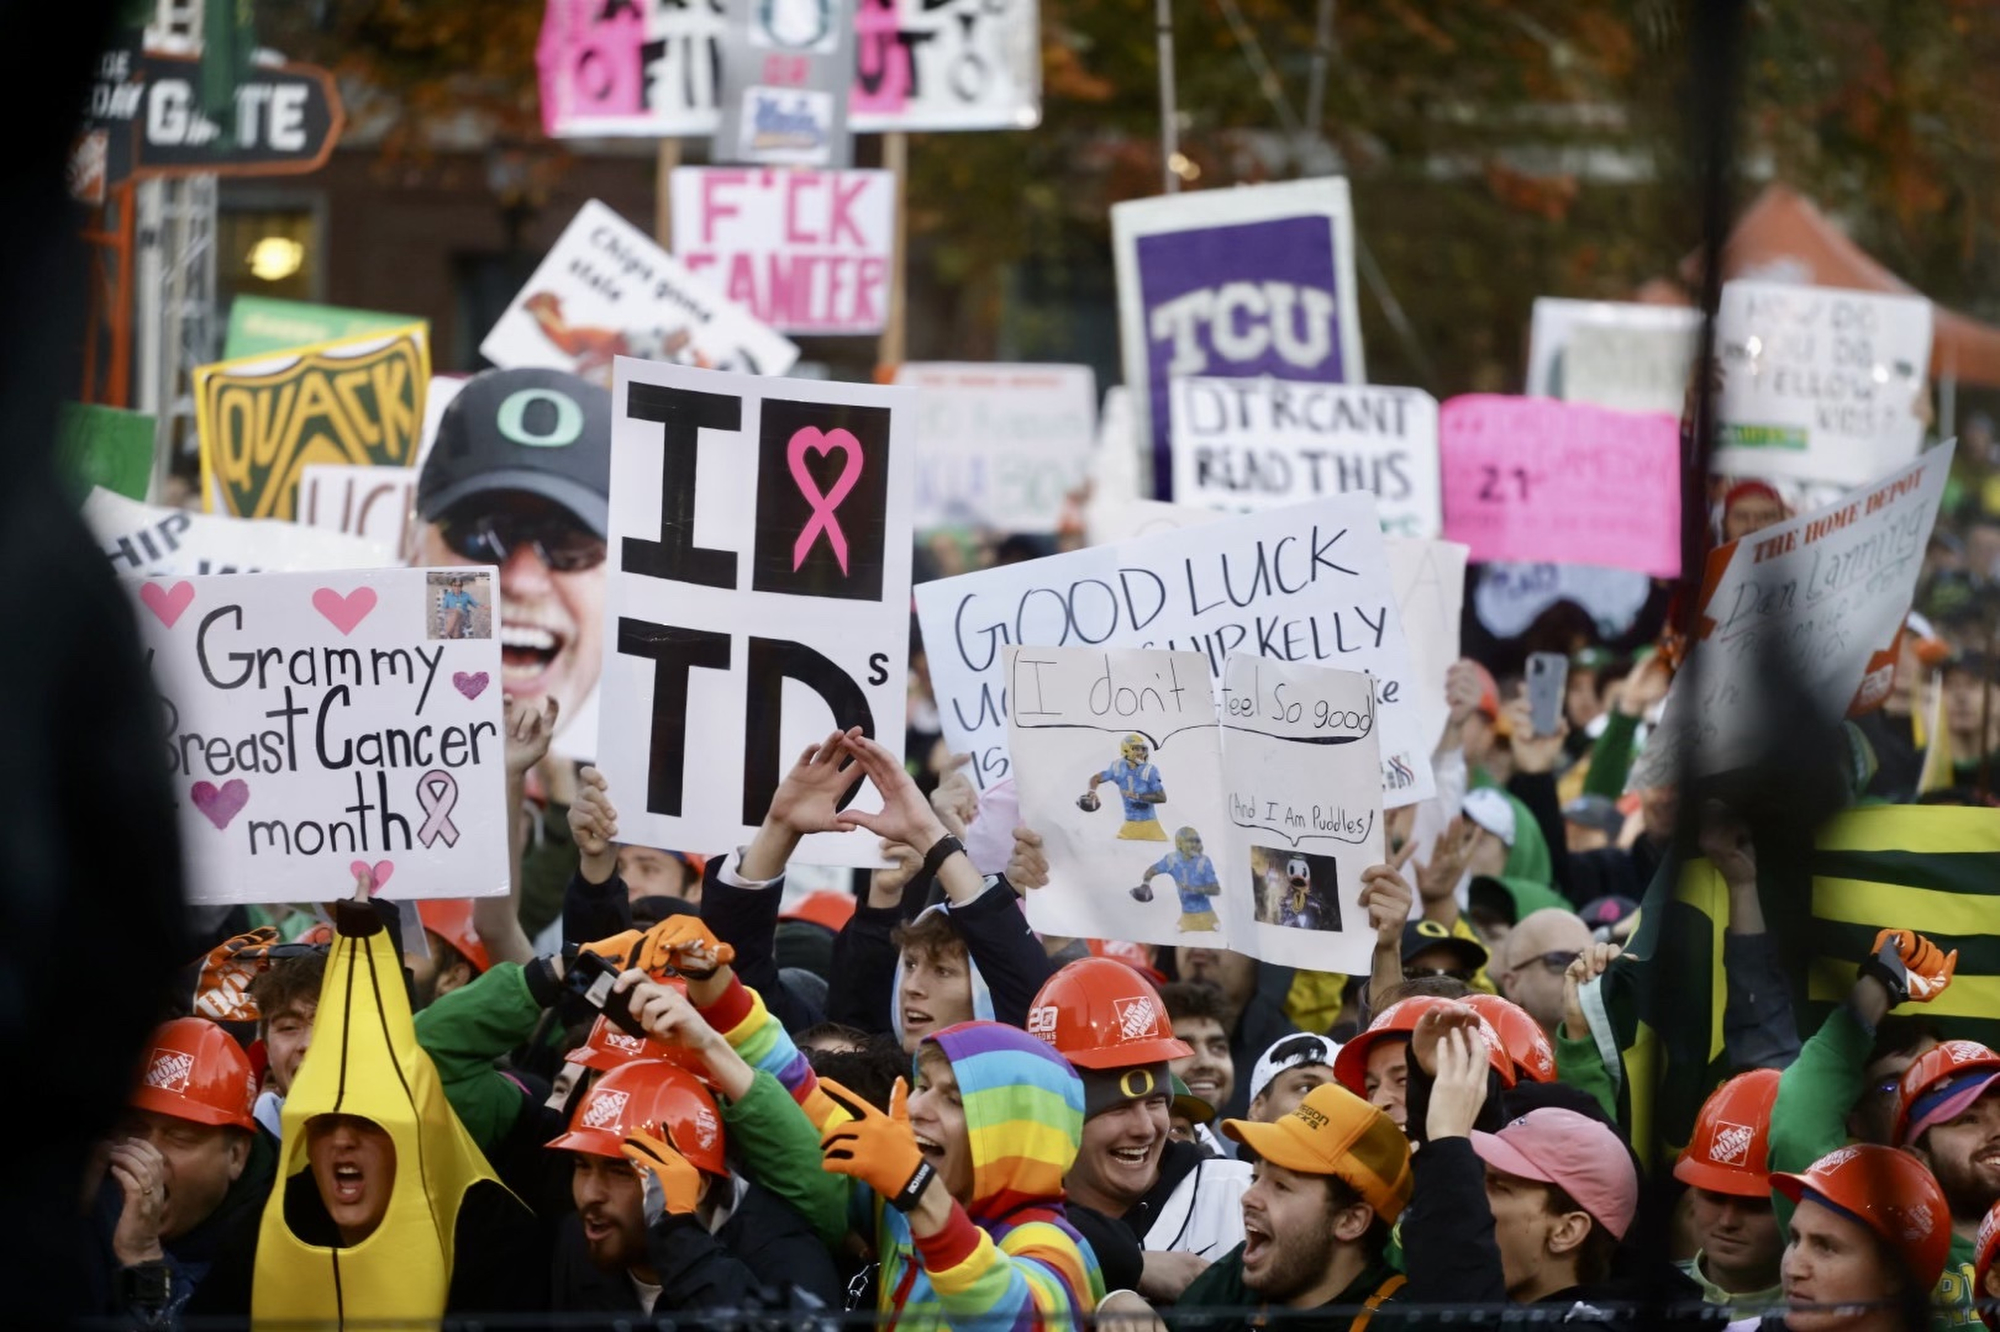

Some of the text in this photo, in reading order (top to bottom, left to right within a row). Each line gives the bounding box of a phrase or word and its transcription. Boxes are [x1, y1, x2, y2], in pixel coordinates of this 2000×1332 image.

[1150, 280, 1335, 376] TCU
[218, 357, 413, 493] QUACK
[497, 387, 585, 448] O
[620, 380, 742, 590] I
[1298, 449, 1413, 501] THIS
[1753, 465, 1926, 564] THE HOME DEPOT
[954, 524, 1360, 672] GOOD LUCK
[1255, 606, 1387, 662] KELLY
[197, 604, 445, 716] Grammy
[1018, 660, 1063, 716] I
[1089, 652, 1185, 717] don't
[1313, 694, 1373, 732] good
[315, 684, 497, 770] Cancer
[248, 770, 413, 855] month
[1265, 801, 1279, 821] I
[1284, 806, 1306, 829] Am
[1312, 804, 1365, 835] Puddles
[1122, 997, 1152, 1037] HOME
[146, 1054, 189, 1086] HOME
[1120, 1069, 1154, 1098] O
[1710, 1126, 1753, 1161] HOME
